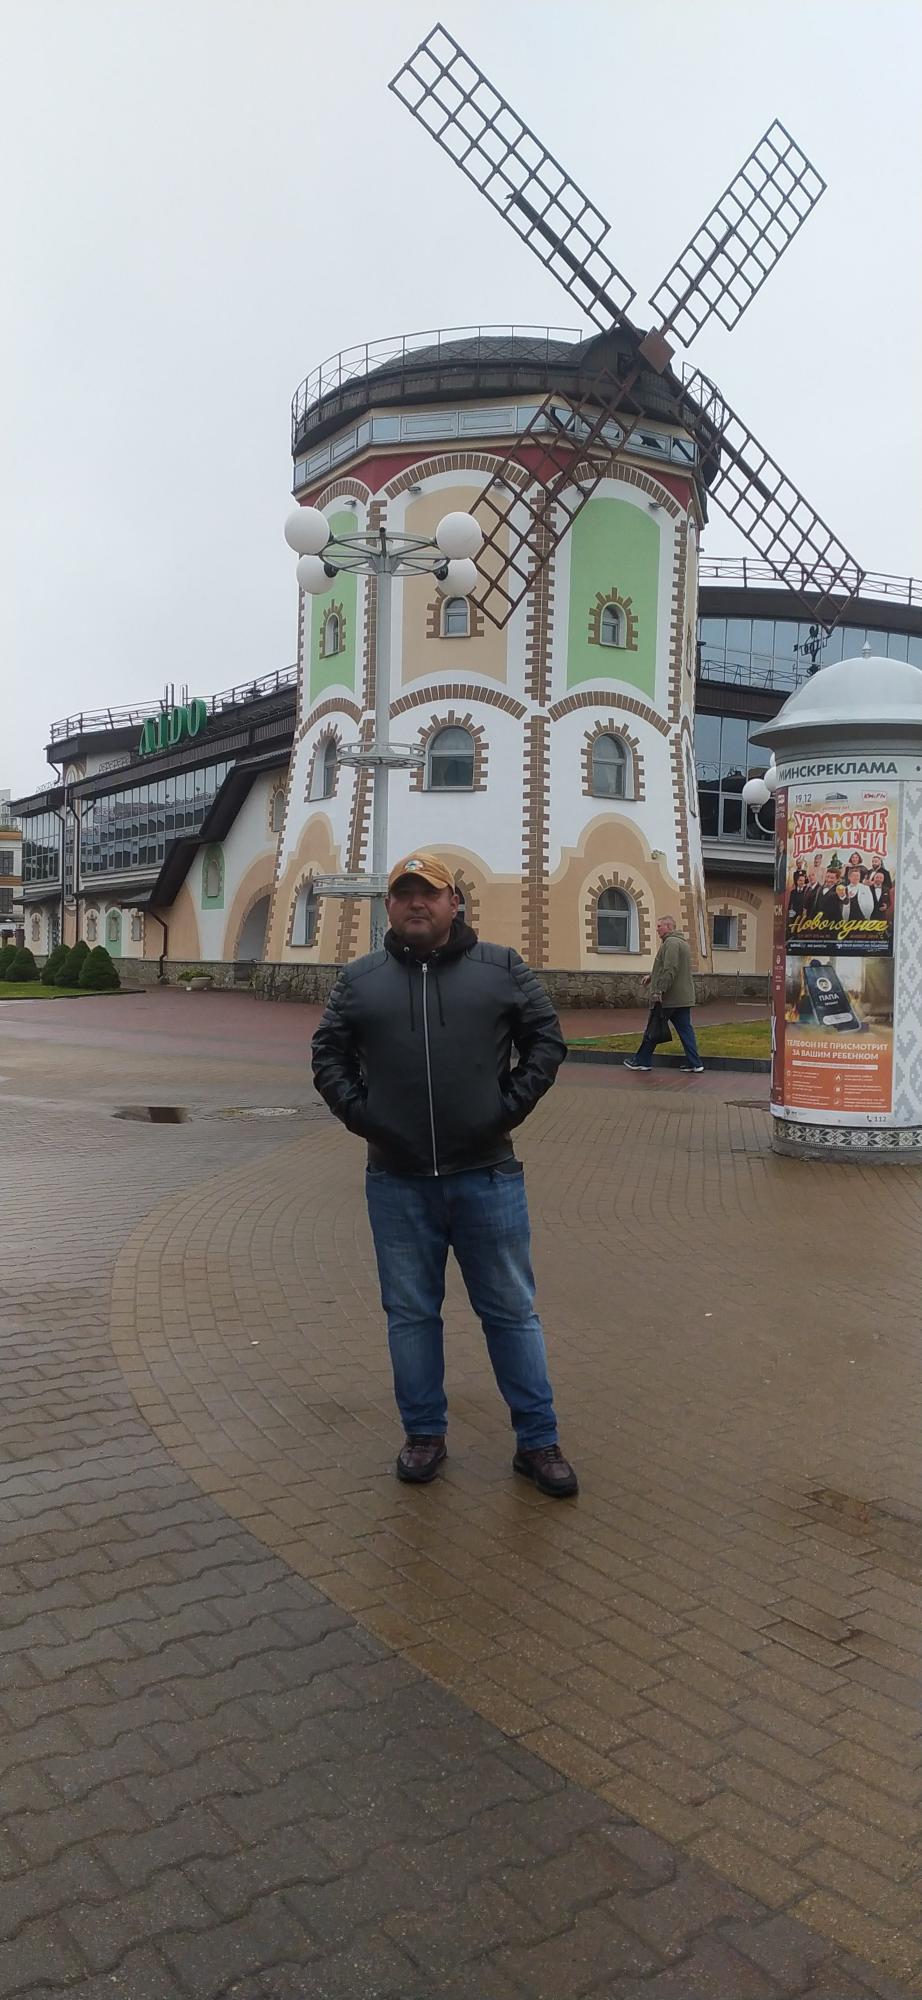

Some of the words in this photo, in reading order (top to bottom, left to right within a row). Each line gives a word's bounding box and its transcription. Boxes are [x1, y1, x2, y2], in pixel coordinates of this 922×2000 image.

[779, 761, 898, 780] МИНСКРЕКЛАМА
[795, 809, 887, 833] УРАЛЬСКИЕ
[794, 831, 887, 856] ПЕЛЬМЕНИ
[789, 912, 889, 940] Новогоднее
[818, 993, 840, 1002] ПАПА
[787, 1039, 817, 1048] ТЕЛЕФОН
[817, 1041, 828, 1049] НЕ
[830, 1042, 889, 1051] ПРИСМОТРИТ
[801, 1050, 831, 1058] ВАШИМ
